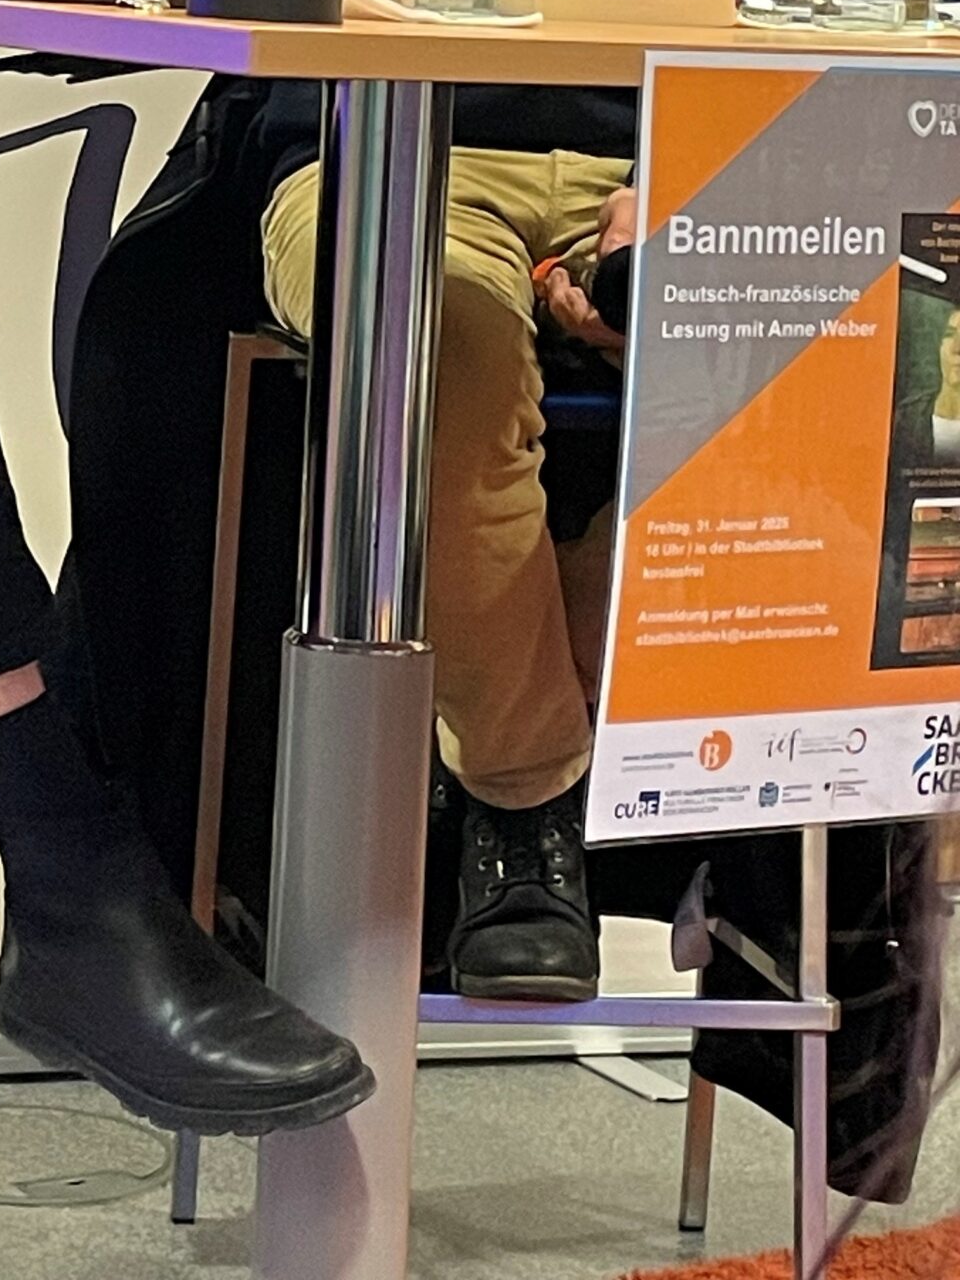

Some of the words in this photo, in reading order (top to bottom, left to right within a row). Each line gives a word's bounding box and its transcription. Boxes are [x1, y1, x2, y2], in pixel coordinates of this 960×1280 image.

[667, 214, 887, 256] Bannmeilen
[663, 284, 862, 303] Deutsch-französische
[660, 321, 730, 343] Lesung
[735, 320, 765, 338] mit
[768, 321, 816, 338] Anne
[820, 320, 878, 337] Weber
